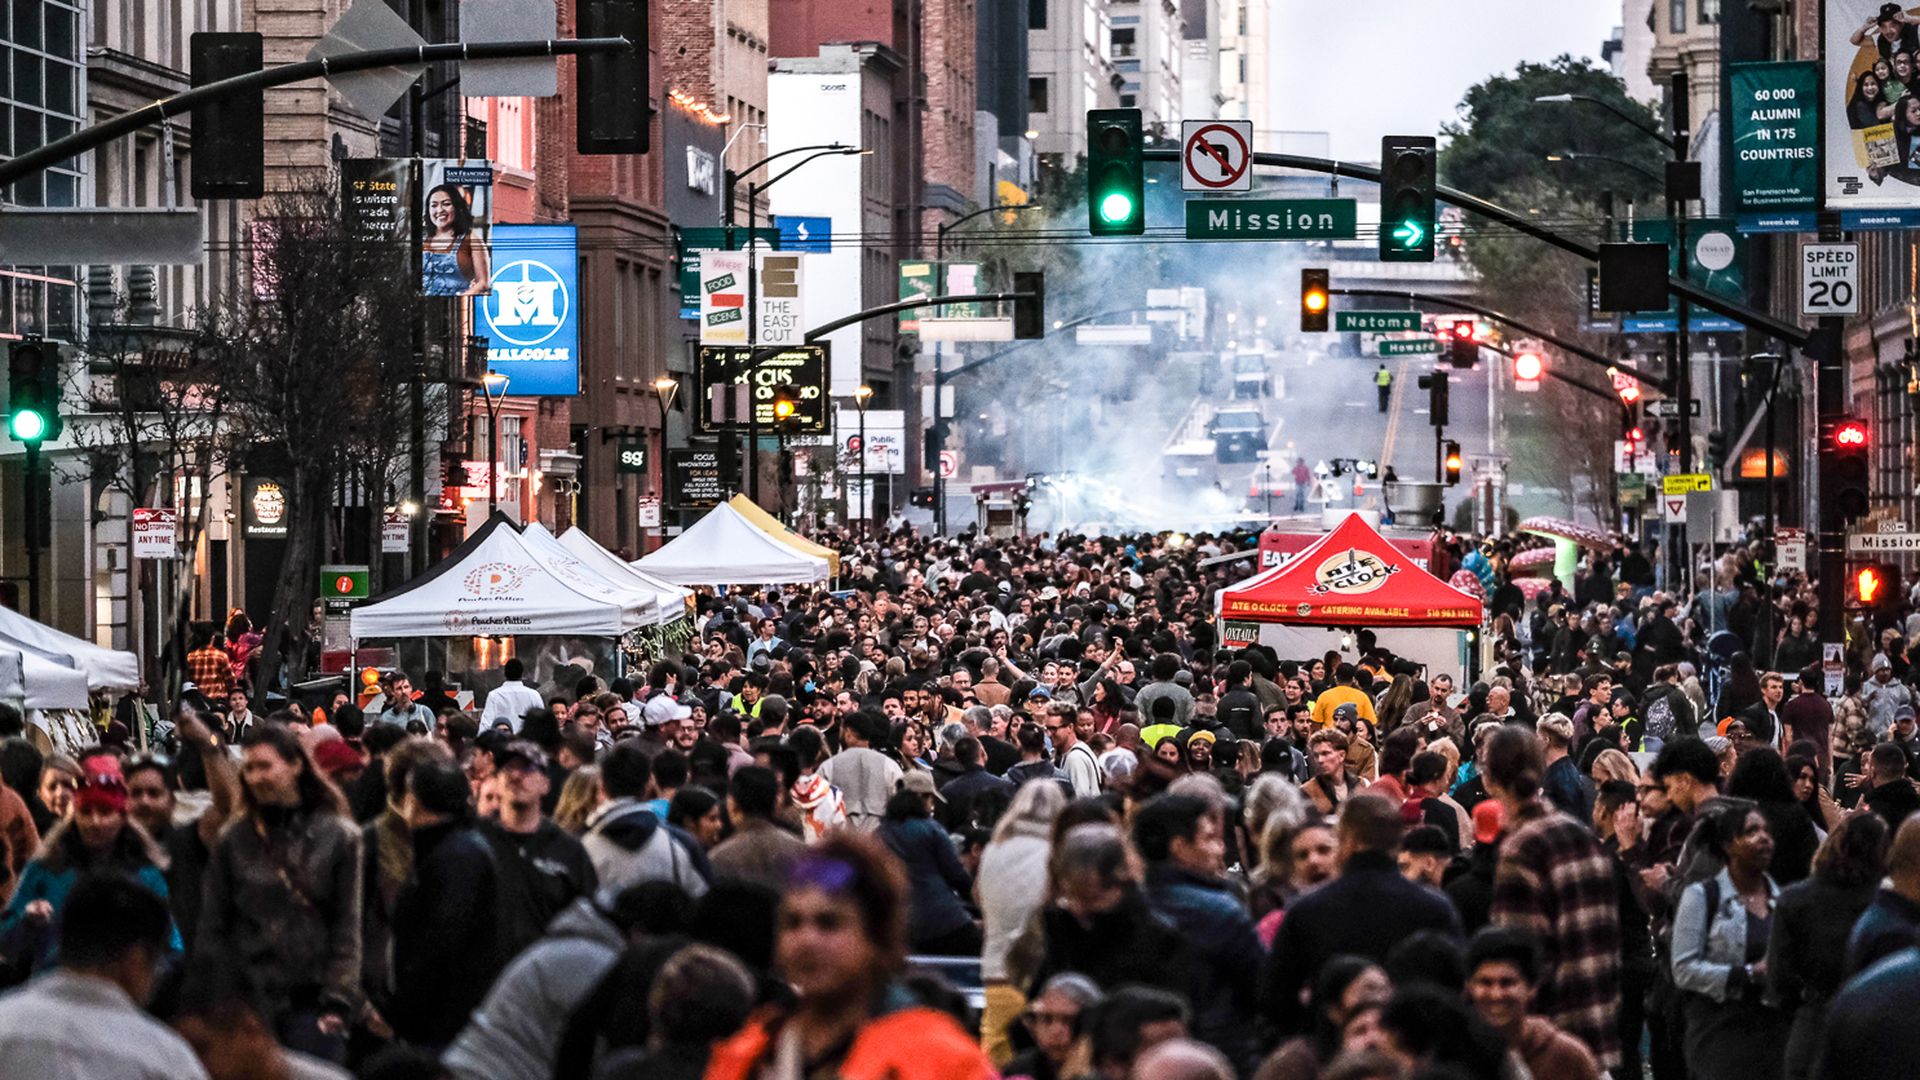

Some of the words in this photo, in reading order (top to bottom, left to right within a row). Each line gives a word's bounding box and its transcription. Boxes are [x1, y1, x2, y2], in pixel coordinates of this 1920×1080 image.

[1754, 90, 1769, 101] 60
[1772, 89, 1795, 100] 000
[1751, 108, 1801, 121] ALUMNI
[1757, 130, 1771, 140] IN
[1775, 128, 1796, 139] 175
[1740, 147, 1814, 161] COUNTRIES
[1786, 187, 1800, 195] Hub
[1208, 208, 1334, 231] Mission
[1806, 251, 1855, 263] SPEED
[1811, 266, 1849, 278] LIMIT
[707, 277, 733, 292] FOOD
[1808, 280, 1853, 307] 20
[763, 300, 791, 314] THE
[709, 312, 739, 324] SCENE
[763, 315, 799, 328] EAST
[1346, 316, 1411, 328] Natoma
[763, 328, 792, 342] CUT
[1389, 343, 1435, 353] Howard
[486, 347, 570, 362] MALCOLM
[870, 436, 896, 444] Public
[621, 450, 644, 466] sg
[693, 453, 716, 461] FOCUS
[135, 522, 148, 530] NO
[138, 535, 153, 544] ANY
[155, 535, 171, 544] TIME
[1327, 558, 1375, 577] ATE
[1232, 602, 1249, 611] ATE
[1321, 606, 1362, 615] CATERING
[1364, 607, 1409, 617] AVAILABLE
[471, 615, 503, 625] Peaches
[504, 615, 532, 625] Patties
[1225, 627, 1257, 641] OXTAILS
